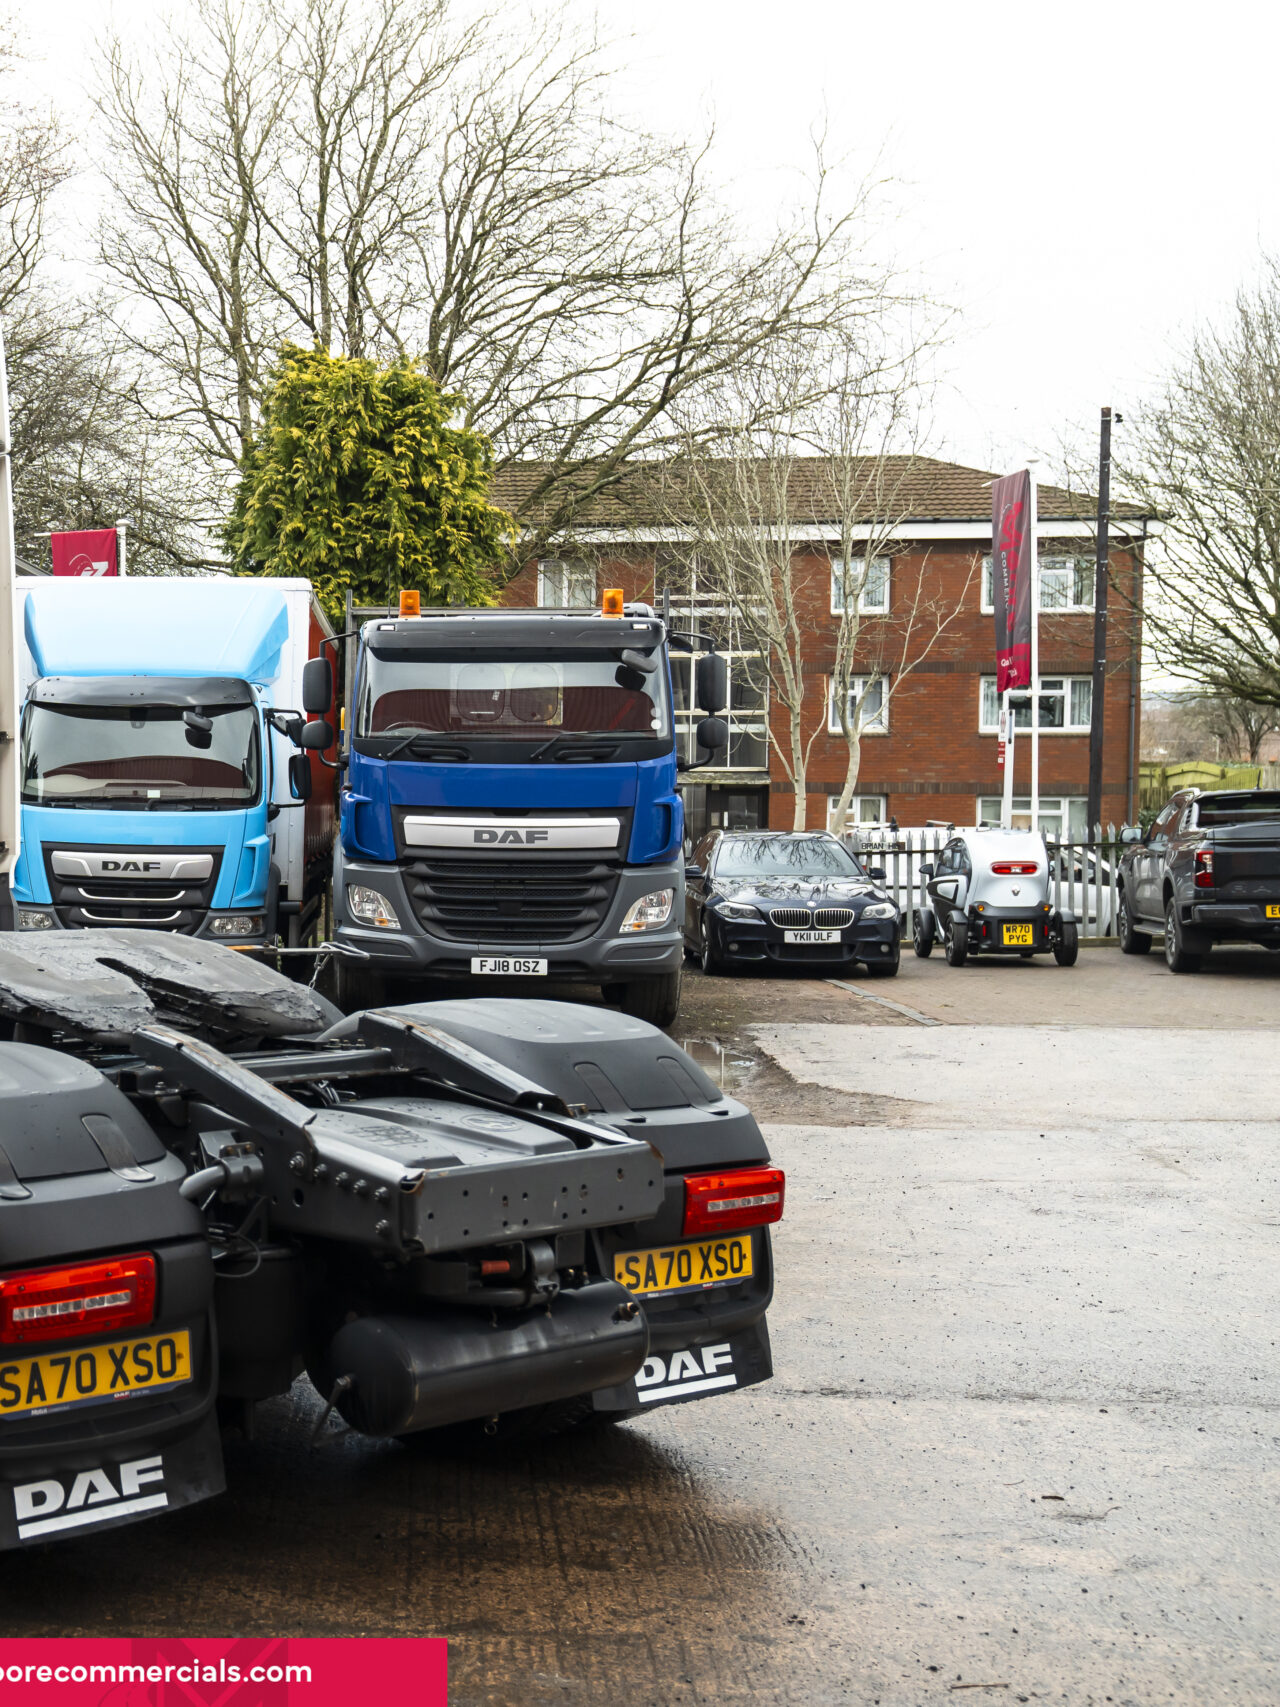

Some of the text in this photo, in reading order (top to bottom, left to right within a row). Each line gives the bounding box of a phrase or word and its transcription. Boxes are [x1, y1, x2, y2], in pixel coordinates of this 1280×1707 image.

[474, 830, 548, 844] DAF
[861, 842, 884, 850] BRIAN
[102, 861, 161, 872] DAF
[1005, 925, 1030, 934] WR70
[793, 932, 833, 941] YK11 ULF
[1009, 934, 1027, 943] PYG
[480, 960, 540, 973] FJ18 OSZ
[625, 1240, 744, 1290] SA70 XSO
[108, 1338, 177, 1389] XSO
[634, 1343, 733, 1388] DAF
[13, 1455, 164, 1521] DAF
